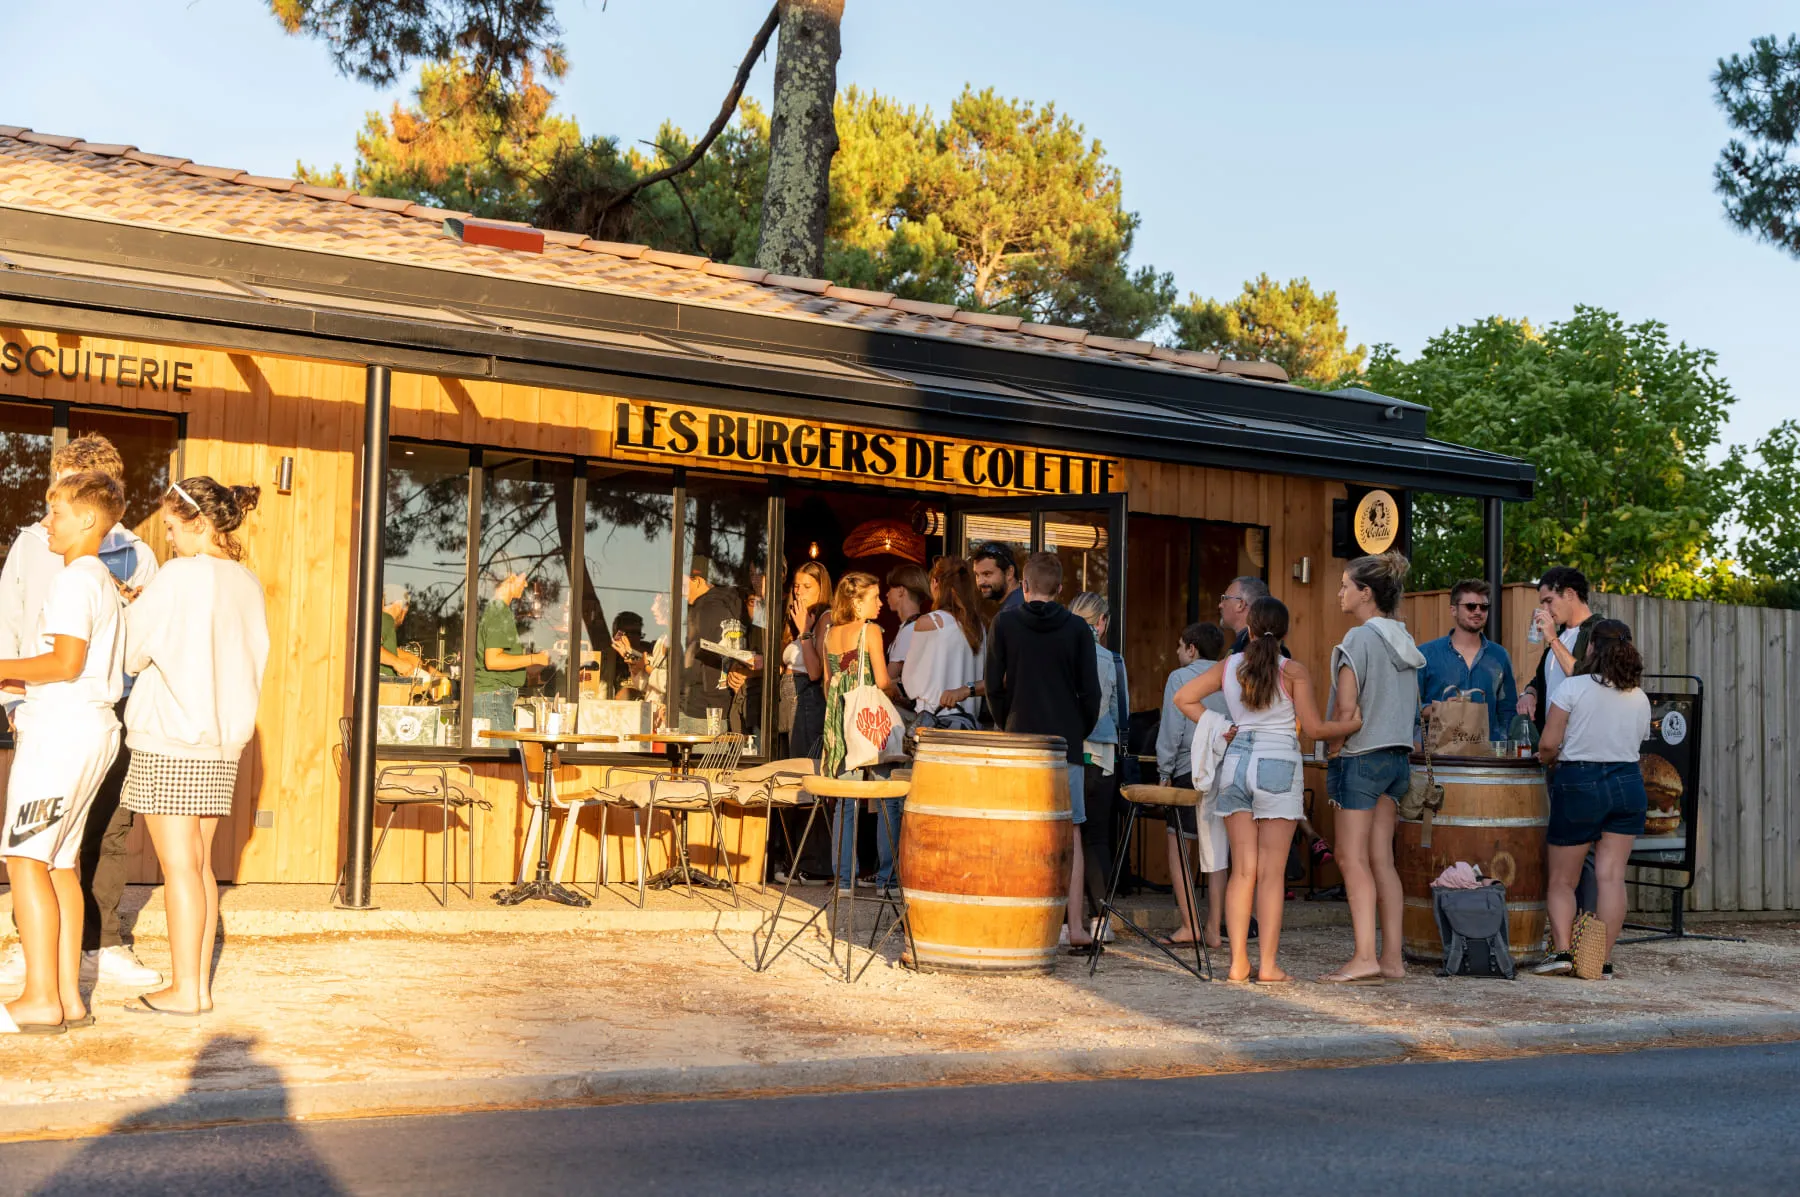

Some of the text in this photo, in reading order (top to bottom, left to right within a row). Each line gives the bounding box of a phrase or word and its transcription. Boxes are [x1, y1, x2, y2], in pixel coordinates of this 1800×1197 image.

[1, 342, 193, 393] SCUITERIE
[615, 402, 1119, 494] LES BURGERS DE COLETTE
[15, 796, 64, 828] NIKE
